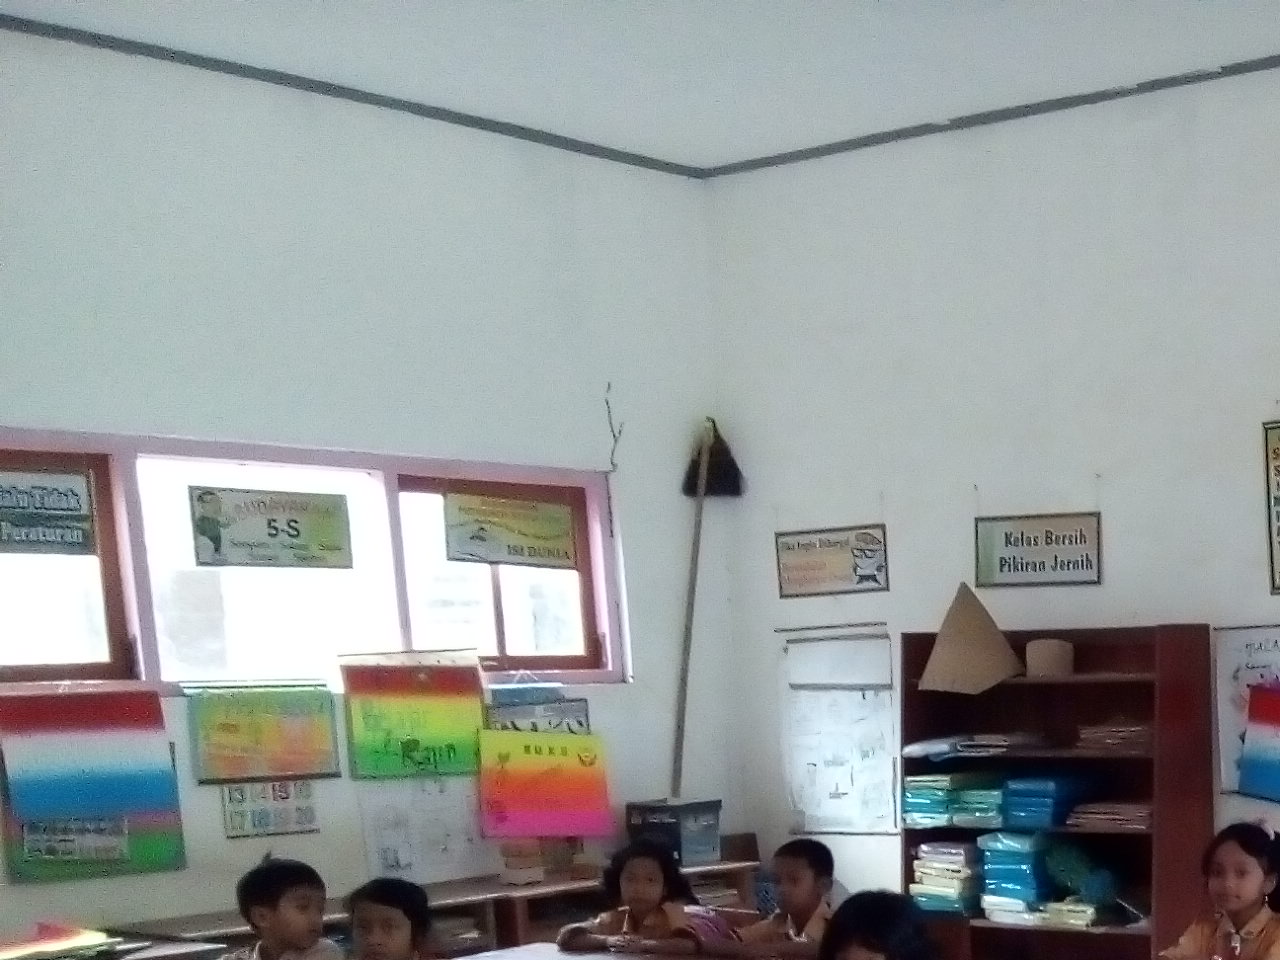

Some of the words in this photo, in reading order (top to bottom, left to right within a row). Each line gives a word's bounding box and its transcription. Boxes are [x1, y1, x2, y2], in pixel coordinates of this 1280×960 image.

[267, 519, 300, 538] 5-S
[1004, 530, 1039, 548] Kelas
[1045, 528, 1087, 546] Bersih
[999, 555, 1045, 573] Pikiran
[1051, 553, 1093, 572] Jernih
